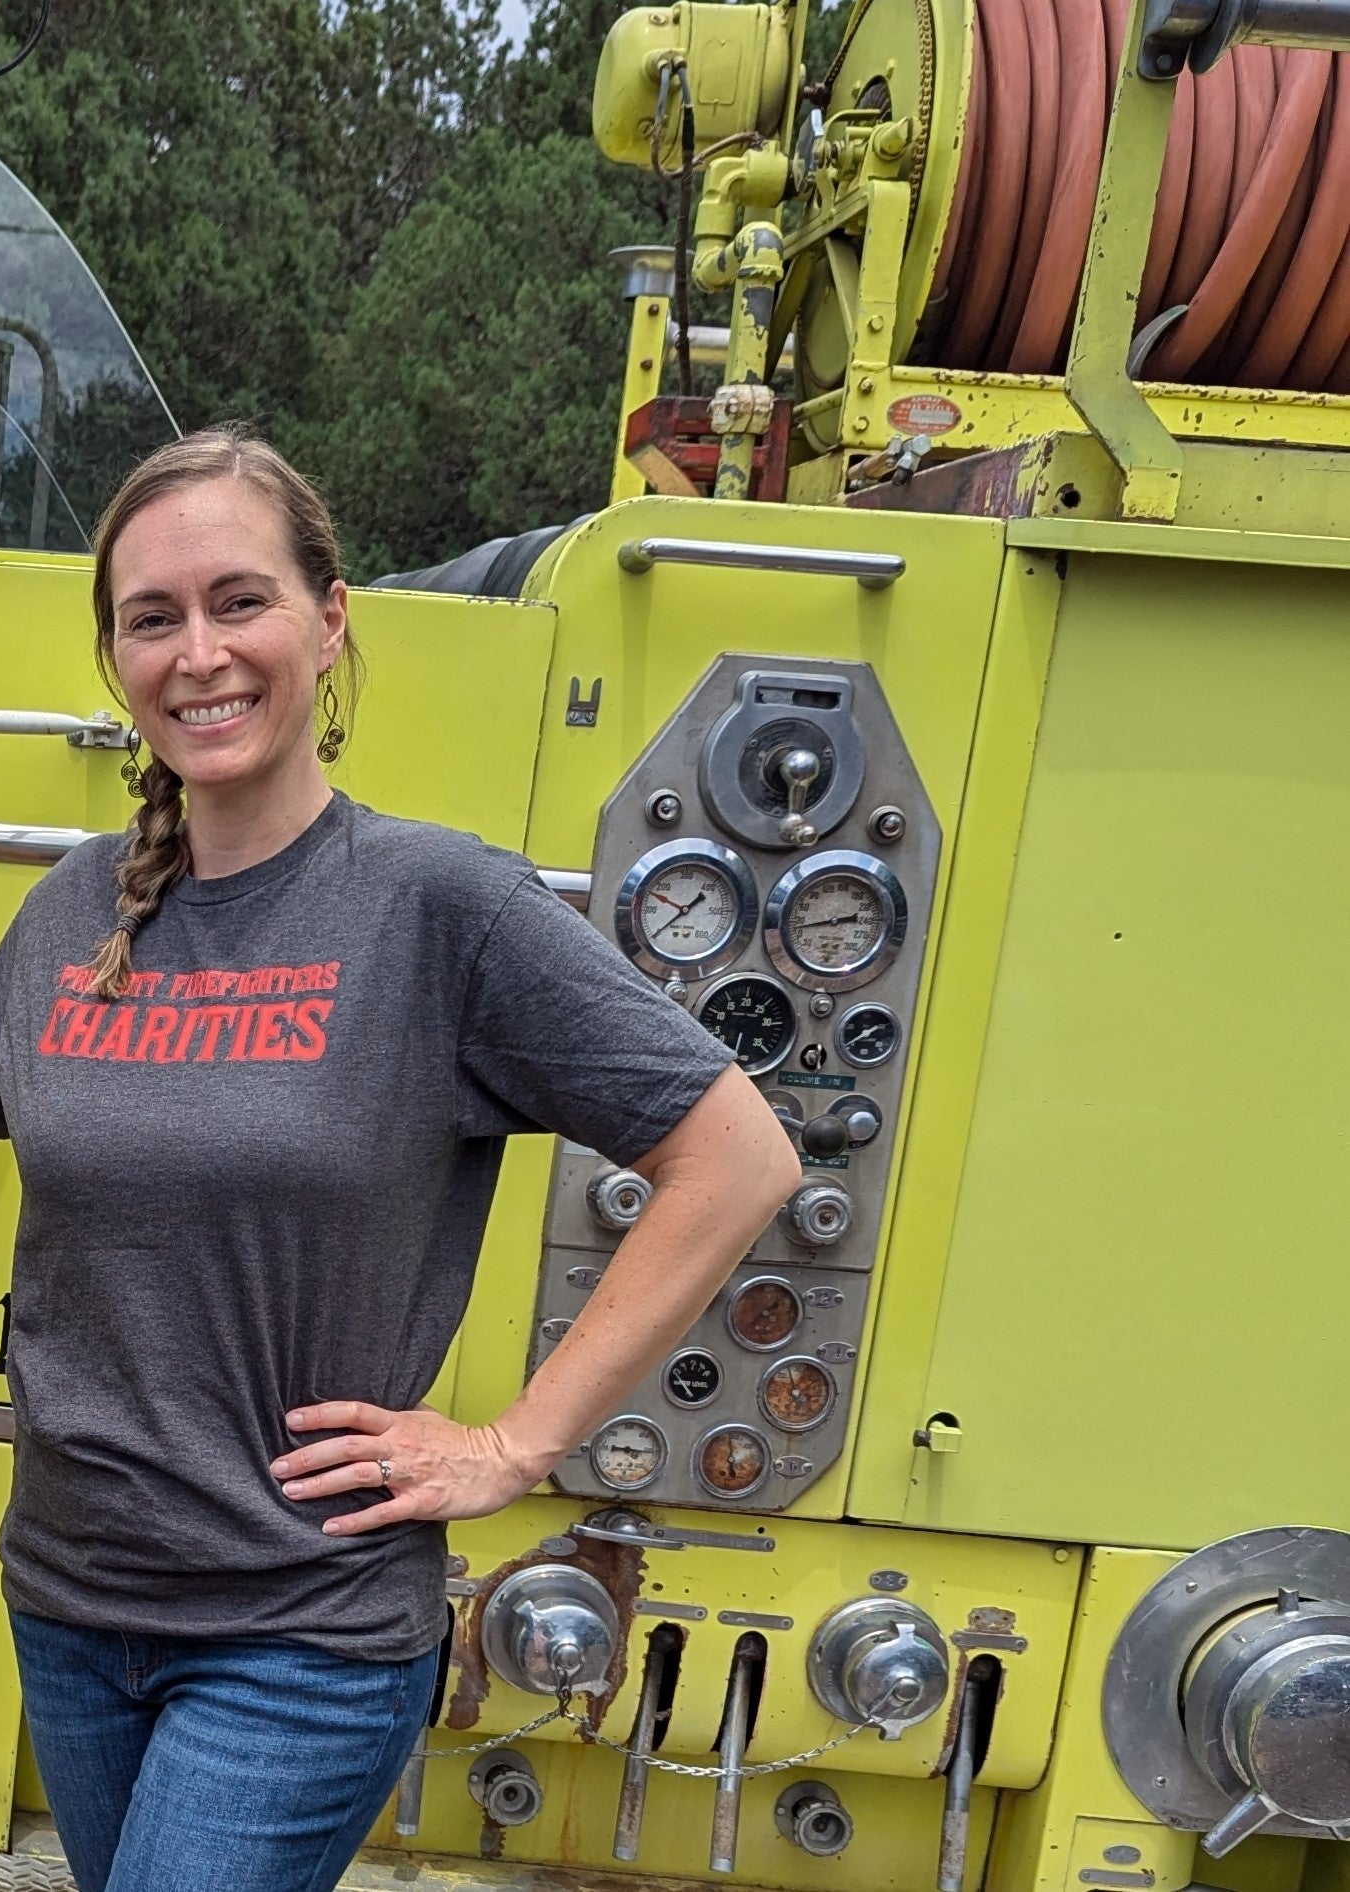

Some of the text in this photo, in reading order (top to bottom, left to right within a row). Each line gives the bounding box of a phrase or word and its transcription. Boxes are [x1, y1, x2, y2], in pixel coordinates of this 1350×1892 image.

[656, 882, 671, 891] 200
[740, 998, 751, 1006] 20
[755, 1004, 765, 1013] 25
[762, 1018, 772, 1026] 30
[38, 997, 335, 1064] CHARITIES
[753, 1038, 763, 1046] 35
